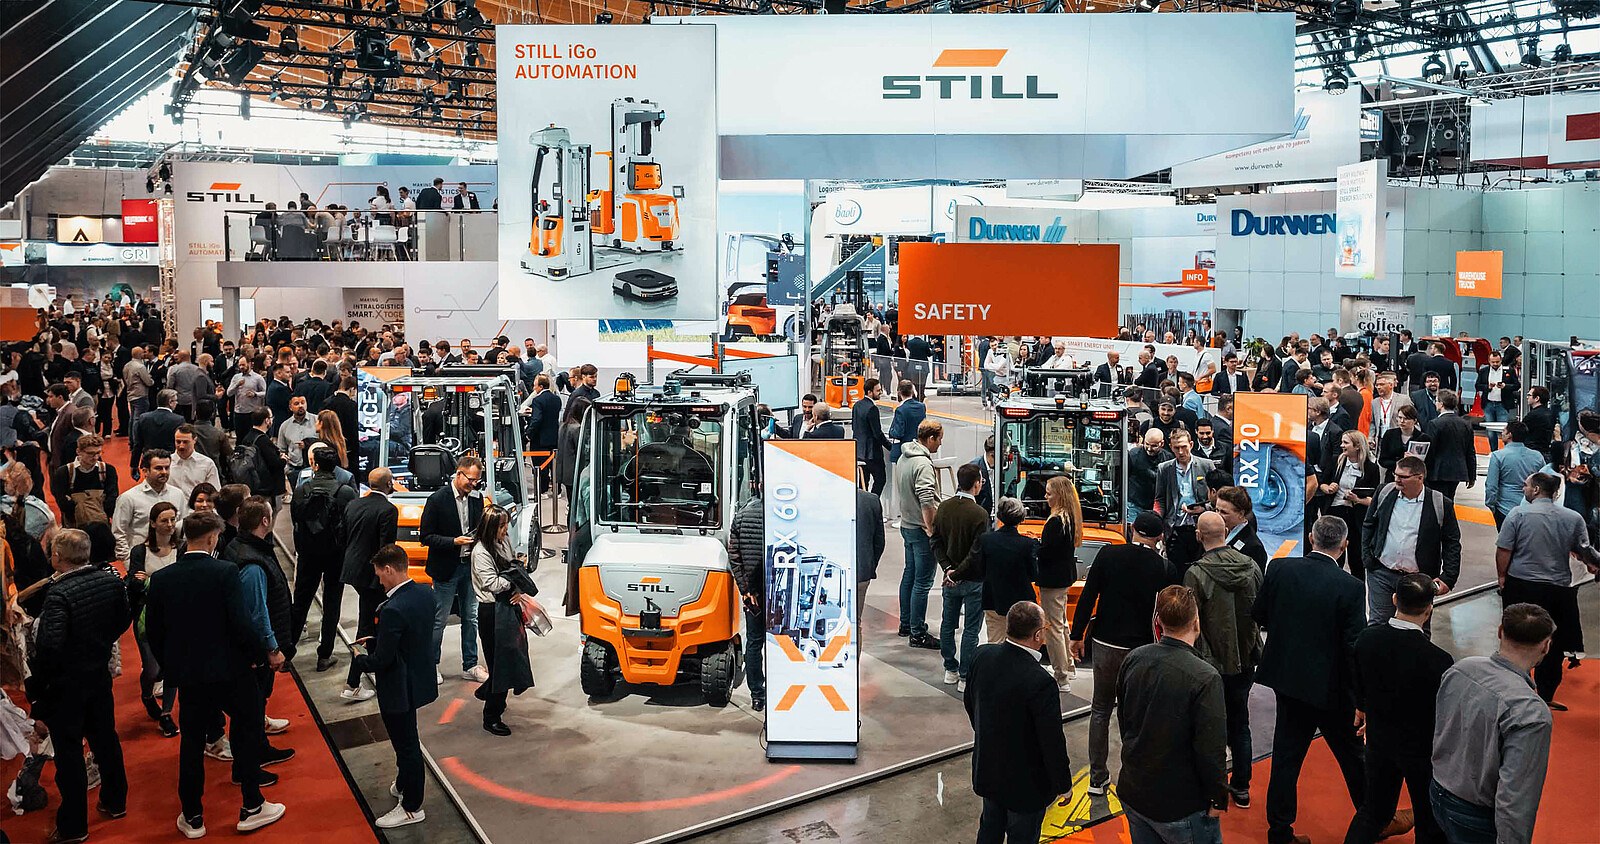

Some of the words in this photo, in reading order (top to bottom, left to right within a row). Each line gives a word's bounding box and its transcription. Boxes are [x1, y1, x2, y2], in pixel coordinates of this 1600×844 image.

[515, 44, 562, 59] STILL
[568, 44, 597, 59] iGo
[515, 64, 637, 79] AUTOMATION
[883, 75, 1058, 99] STILL
[1234, 161, 1283, 171] www.durwen.de
[186, 192, 264, 203] STILL
[122, 249, 149, 260] GRI
[1186, 273, 1203, 281] INFO
[1458, 271, 1487, 281] WAREHOUSE
[1458, 280, 1476, 290] TRUCKS
[914, 302, 992, 321] SAFETY
[1358, 317, 1405, 333] coffee
[1240, 423, 1260, 452] 20
[1240, 457, 1260, 488] RX
[773, 483, 799, 521] 60
[773, 530, 799, 569] RX
[627, 583, 675, 593] STILL
